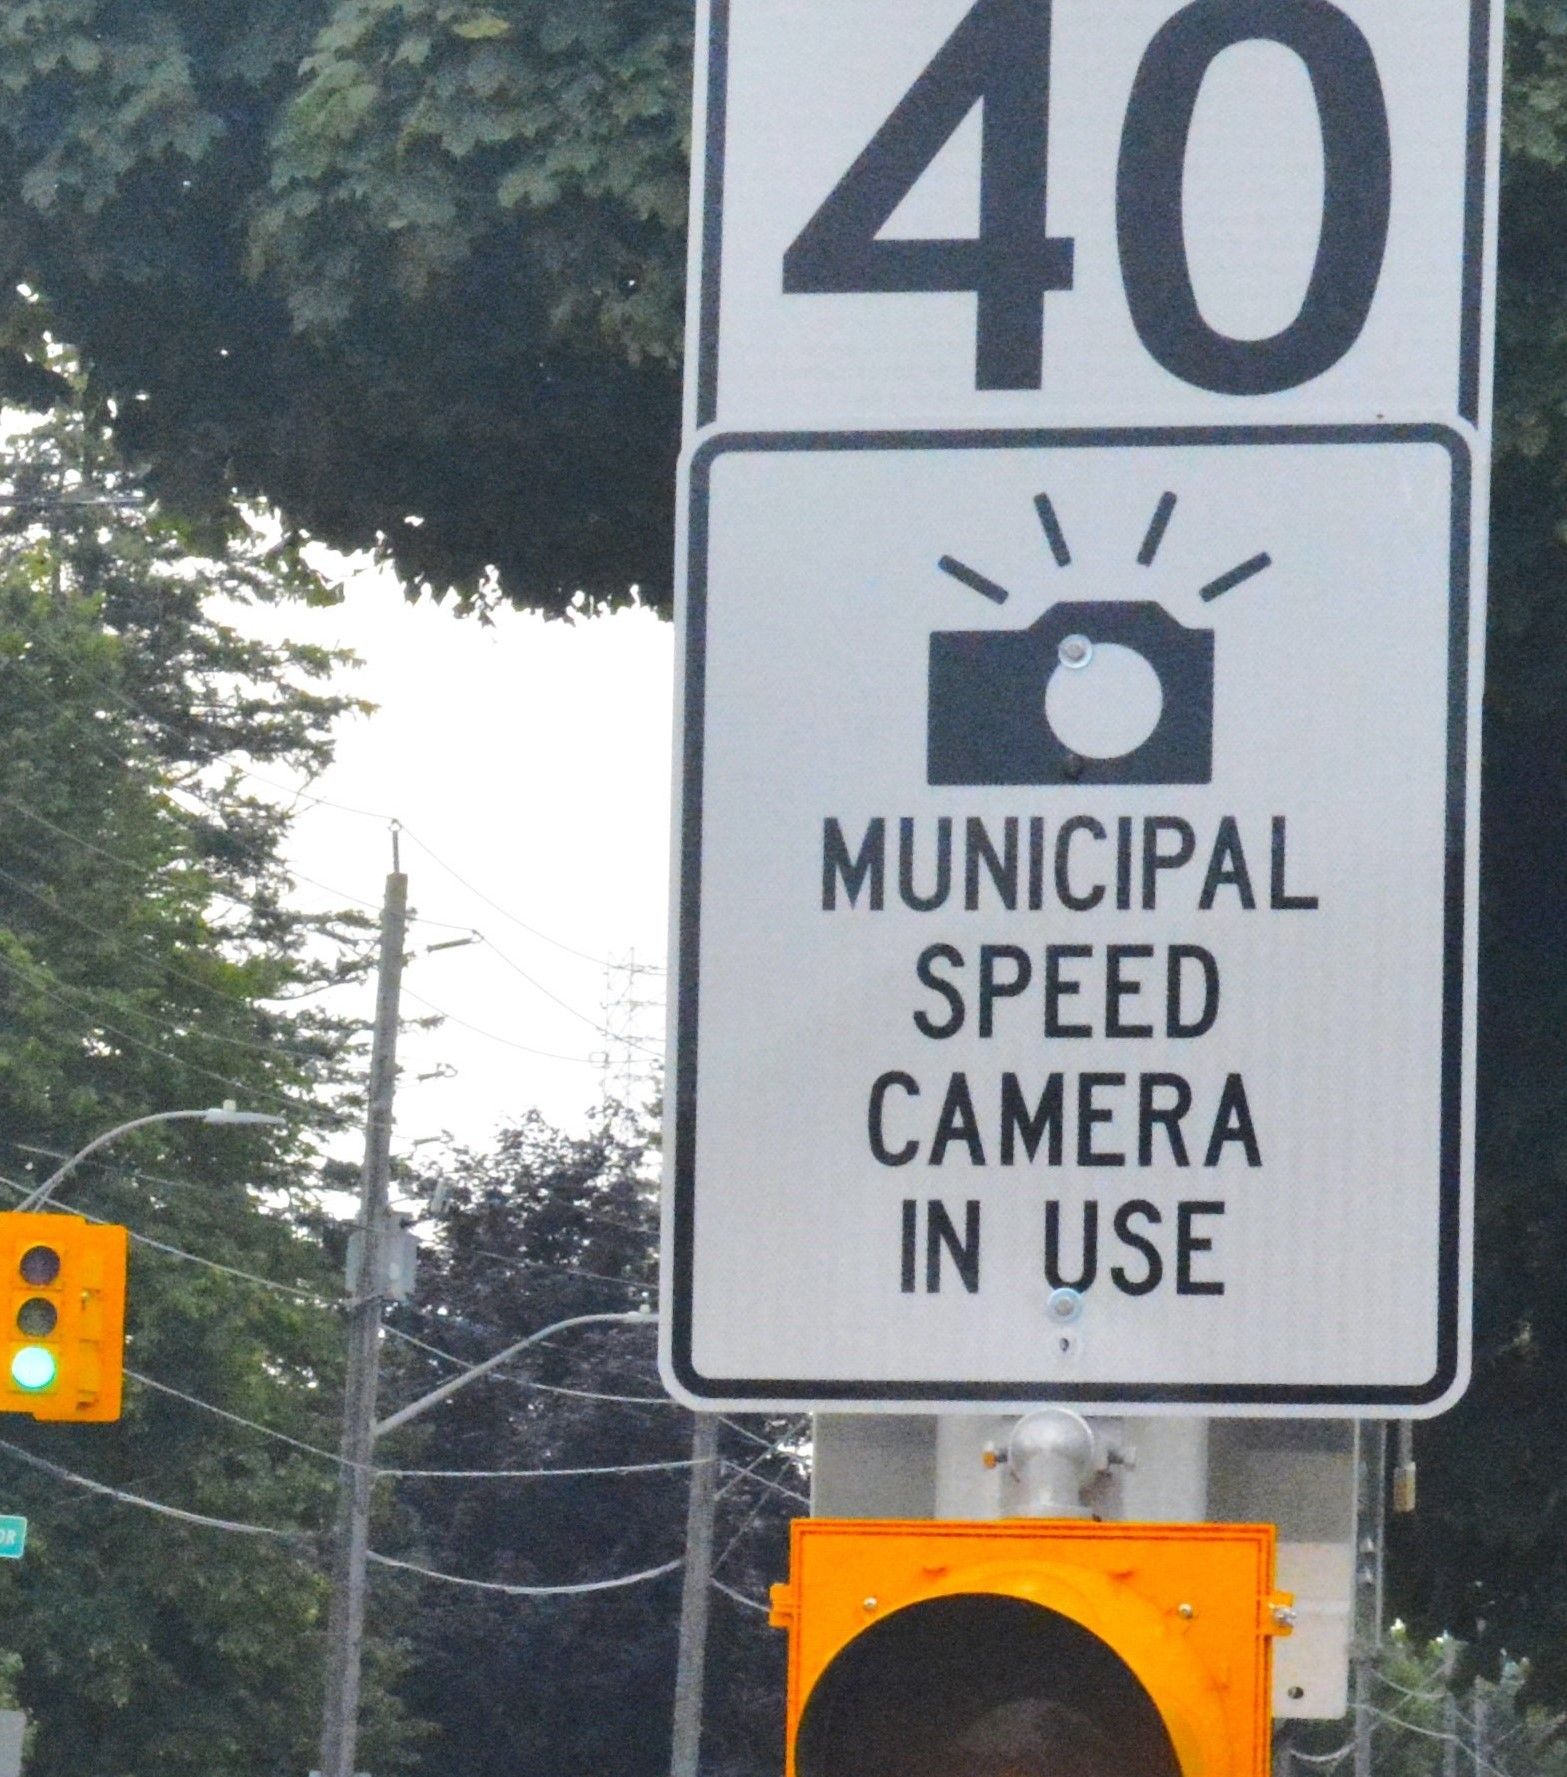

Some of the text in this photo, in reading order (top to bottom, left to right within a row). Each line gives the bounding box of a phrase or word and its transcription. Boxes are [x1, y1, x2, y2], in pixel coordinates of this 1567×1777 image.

[783, 0, 1391, 396] 40
[823, 815, 1320, 911] MUNICIPAL
[913, 943, 1220, 1040] SPEED
[868, 1070, 1263, 1167] CAMERA
[901, 1199, 1225, 1296] IN USE
